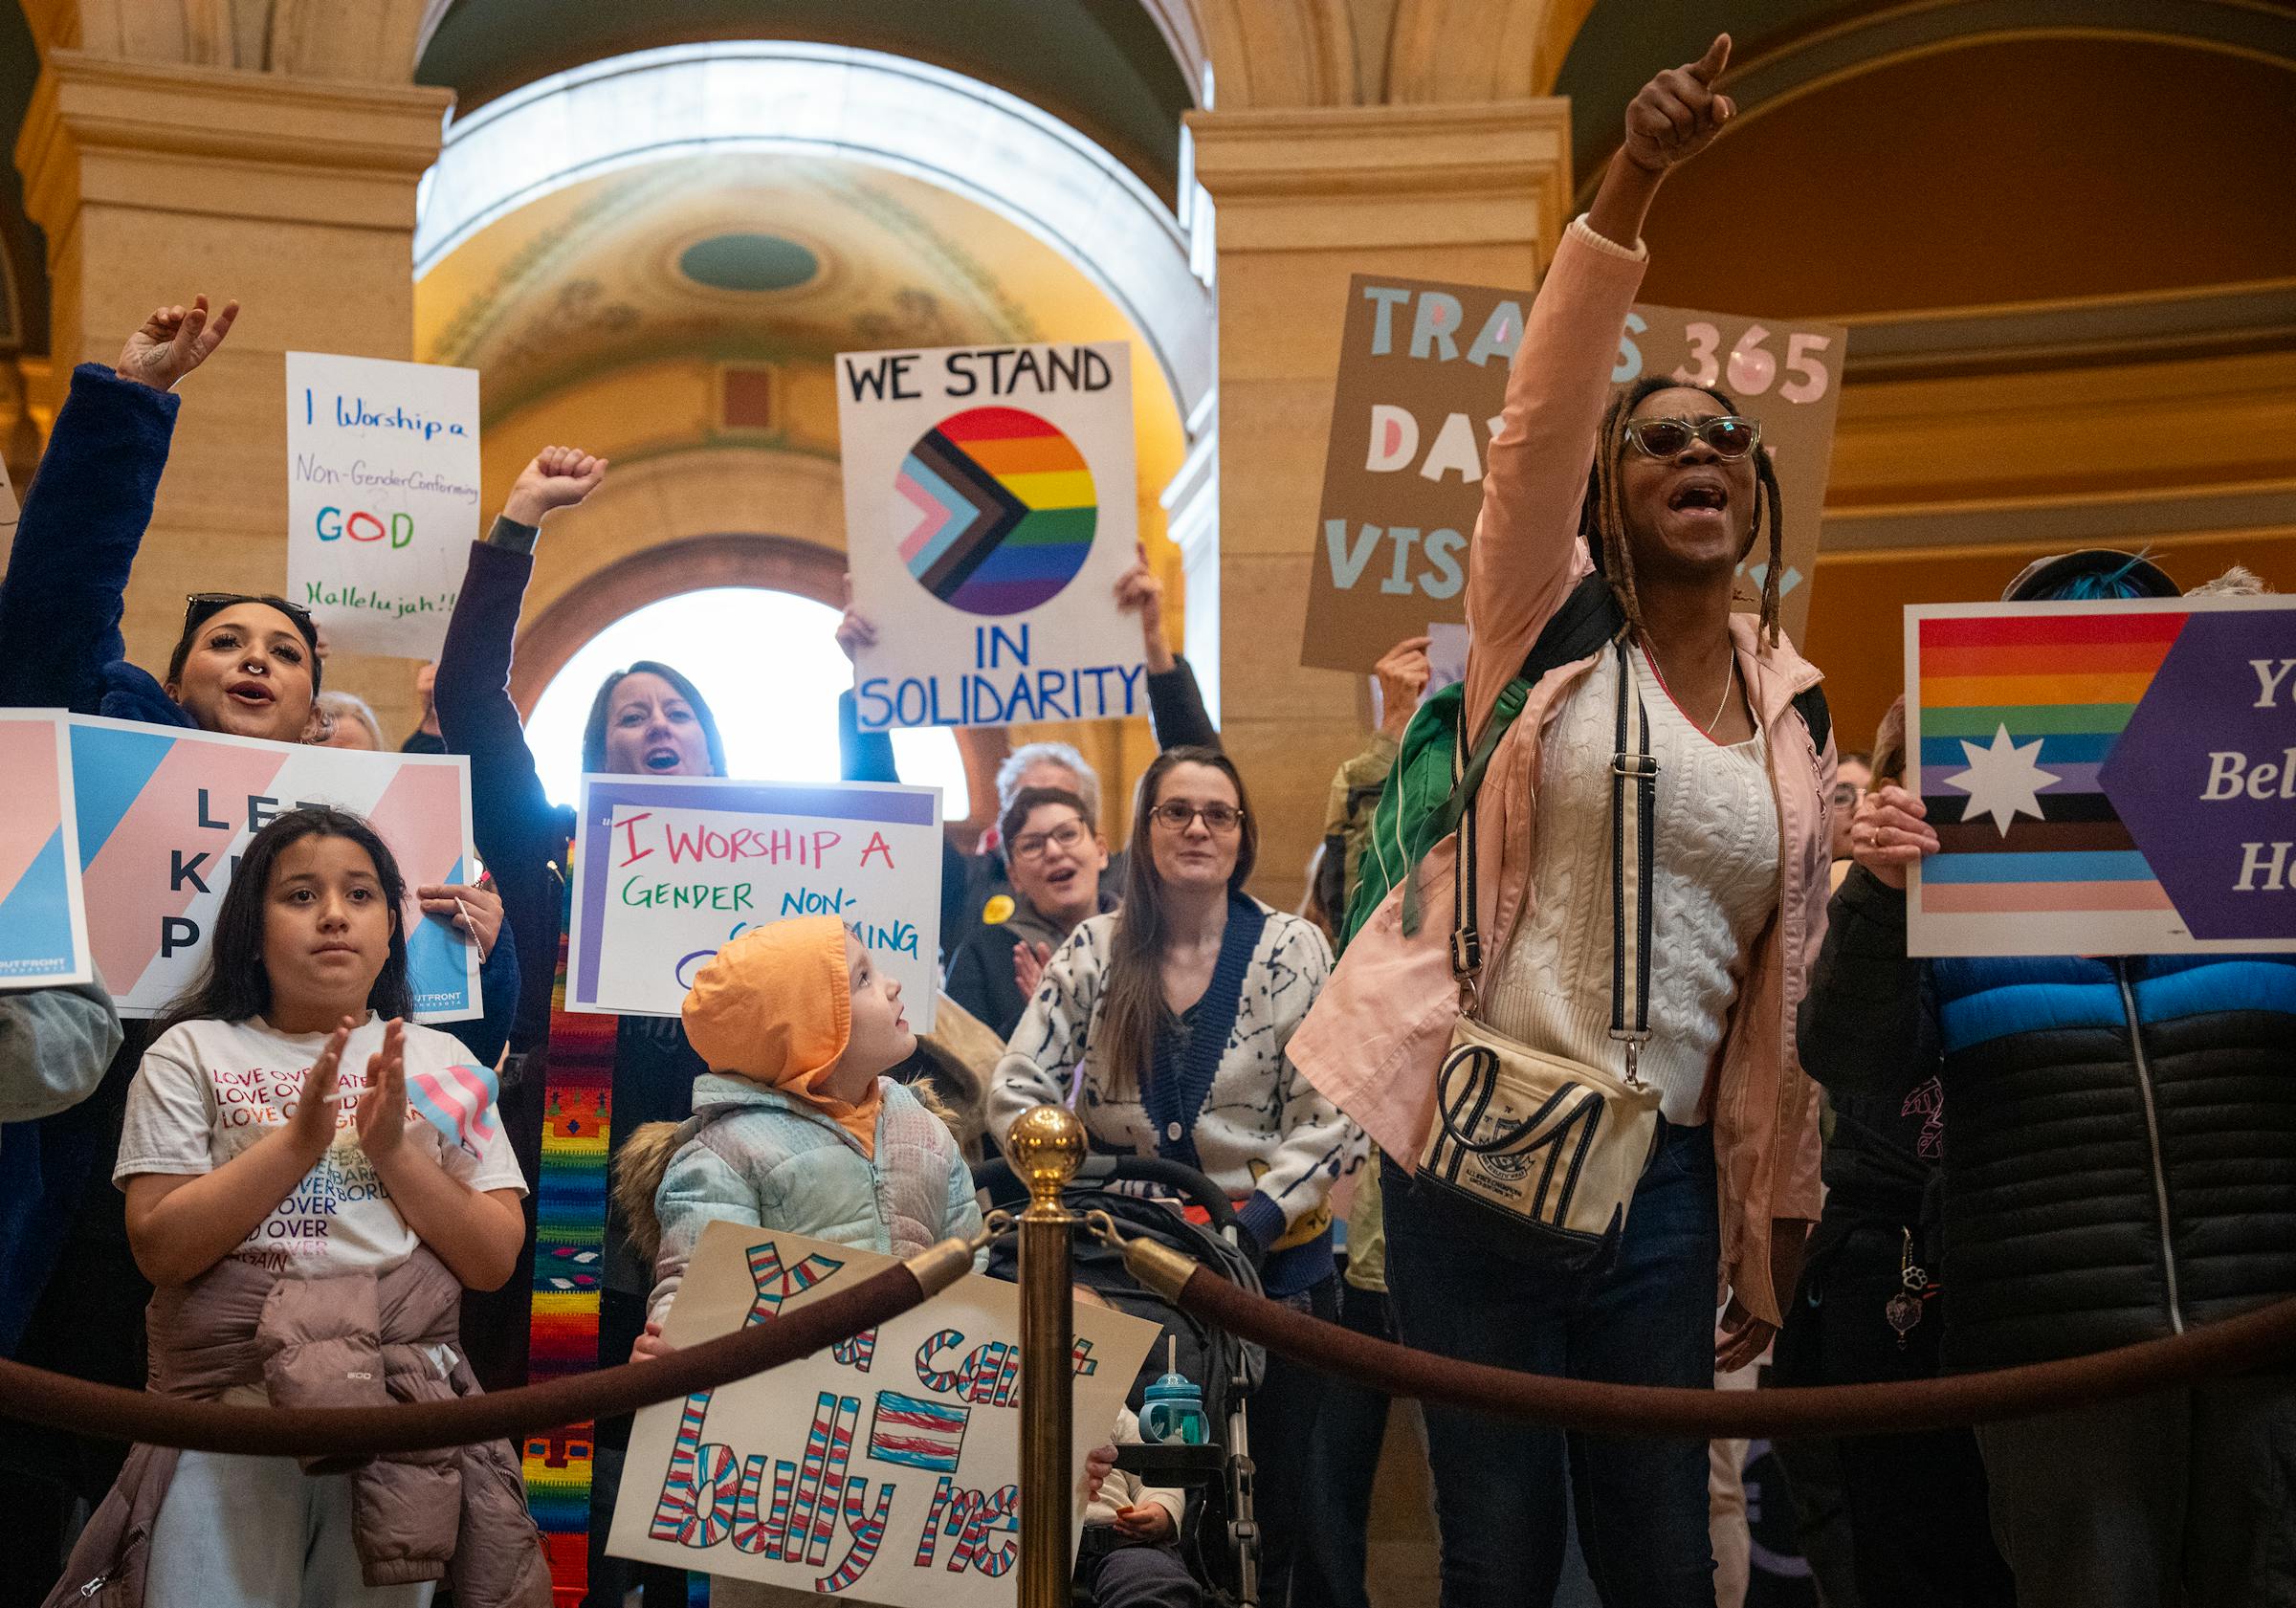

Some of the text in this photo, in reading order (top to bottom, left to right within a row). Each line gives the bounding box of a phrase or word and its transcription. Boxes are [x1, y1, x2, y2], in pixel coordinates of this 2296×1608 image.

[1363, 287, 1832, 405] TRAS 365
[846, 346, 1113, 402] WE STAND
[337, 395, 443, 441] Worship
[449, 424, 468, 438] a
[316, 506, 414, 550] GOD
[976, 623, 1030, 670] IN
[860, 663, 1146, 728] SOLIDARITY
[198, 788, 331, 832] LE
[613, 812, 895, 870] I WORSHIP A
[622, 874, 857, 916] GENDER NON-
[413, 992, 461, 1002] UTFRONT
[213, 1068, 367, 1089] LOVE OVE ATE
[215, 1087, 271, 1106] LOVE
[221, 1107, 279, 1129] LOVE
[277, 1197, 338, 1215] OVER
[299, 1177, 337, 1197] VER
[267, 1219, 328, 1239] OVER
[268, 1240, 328, 1257] OVER
[239, 1252, 288, 1272] GAIN
[648, 1388, 897, 1593] bully
